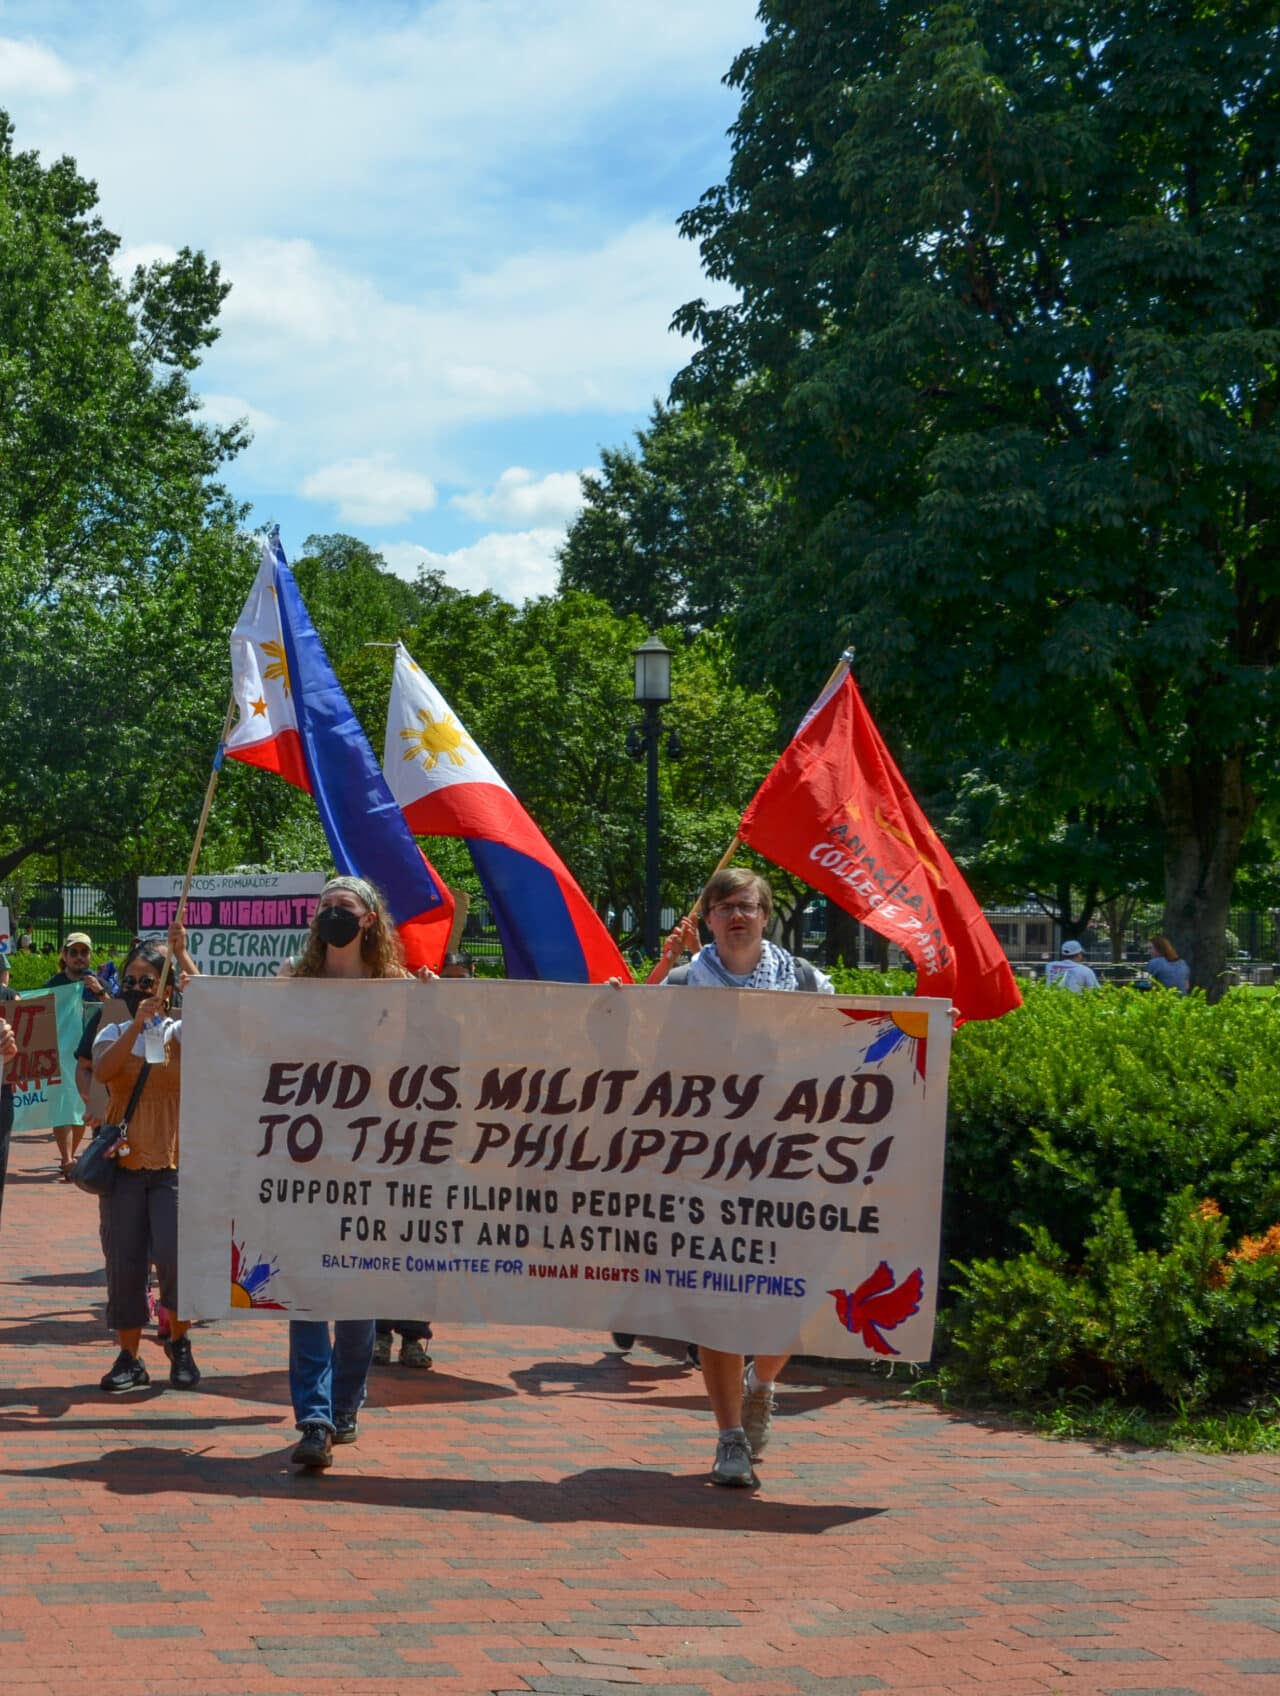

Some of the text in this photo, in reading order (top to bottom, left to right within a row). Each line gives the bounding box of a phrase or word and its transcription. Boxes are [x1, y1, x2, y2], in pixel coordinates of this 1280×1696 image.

[809, 843, 939, 976] COLLEGE PARK
[262, 1060, 895, 1125] END U.S. MILITARY AID
[256, 1113, 895, 1186] TO THE PHILIPPINES!
[259, 1178, 880, 1234] SUPPORT THE FILIPINO PEOPLE'S STRUGGLE
[340, 1216, 777, 1264] FOR JUST AND LASTING PEACE!
[322, 1254, 806, 1298] BALTIMORE COMMITTEE FOR HUMAN RIGHTS IN THE PHILIPPINES
